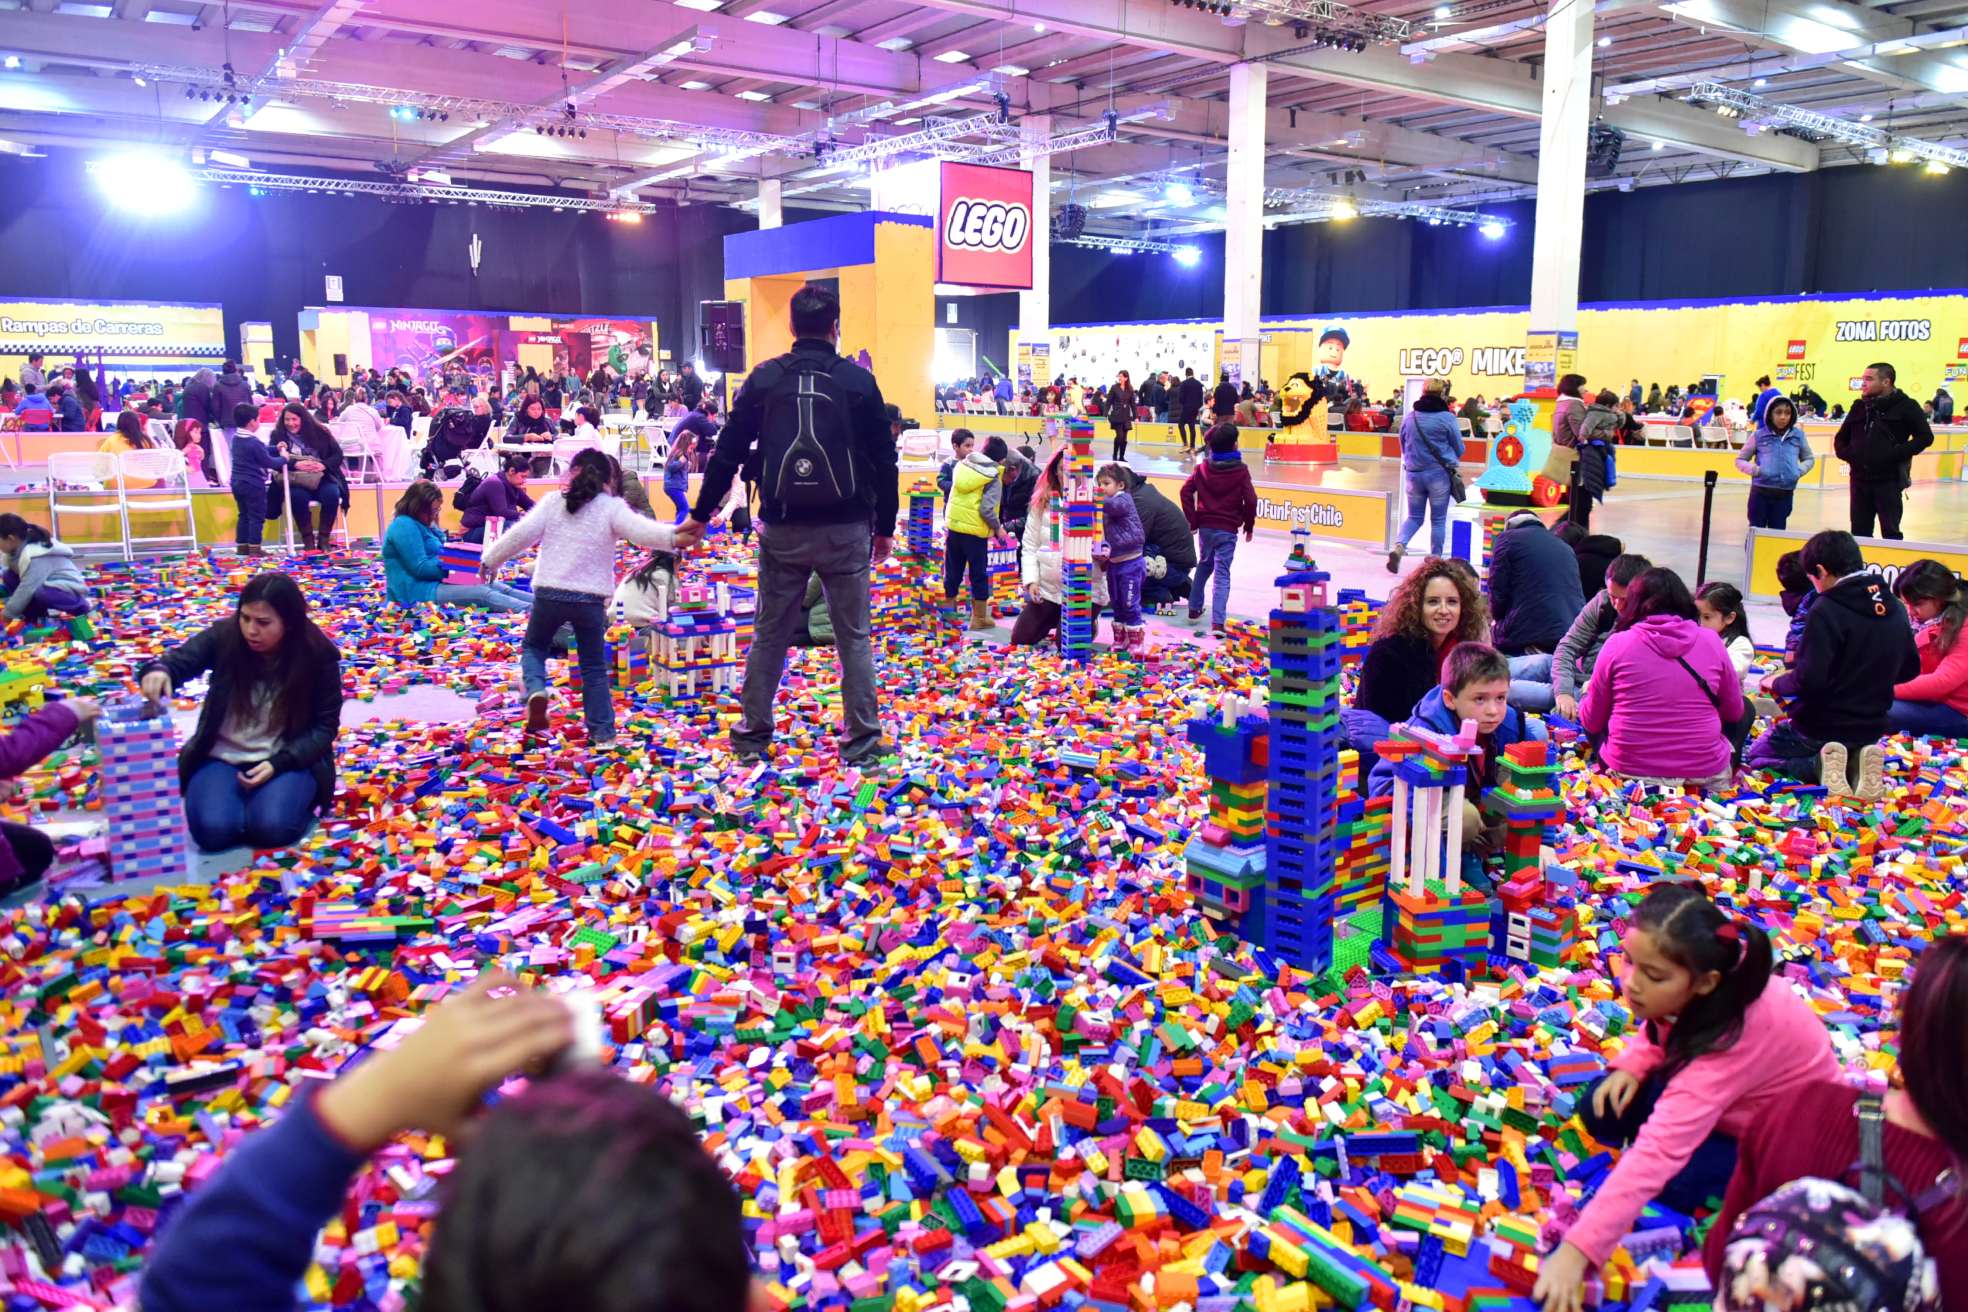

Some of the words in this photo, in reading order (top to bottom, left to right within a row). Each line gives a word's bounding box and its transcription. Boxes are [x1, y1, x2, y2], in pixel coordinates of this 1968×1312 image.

[947, 200, 1027, 250] LEGO
[1, 317, 69, 337] Rampas
[71, 319, 93, 335] de
[94, 319, 164, 335] Carreras
[1835, 320, 1877, 341] ZONA
[1880, 319, 1931, 341] FOTOS
[1471, 347, 1526, 376] MIKE
[1795, 363, 1816, 380] FEST
[1866, 584, 1887, 617] EVO
